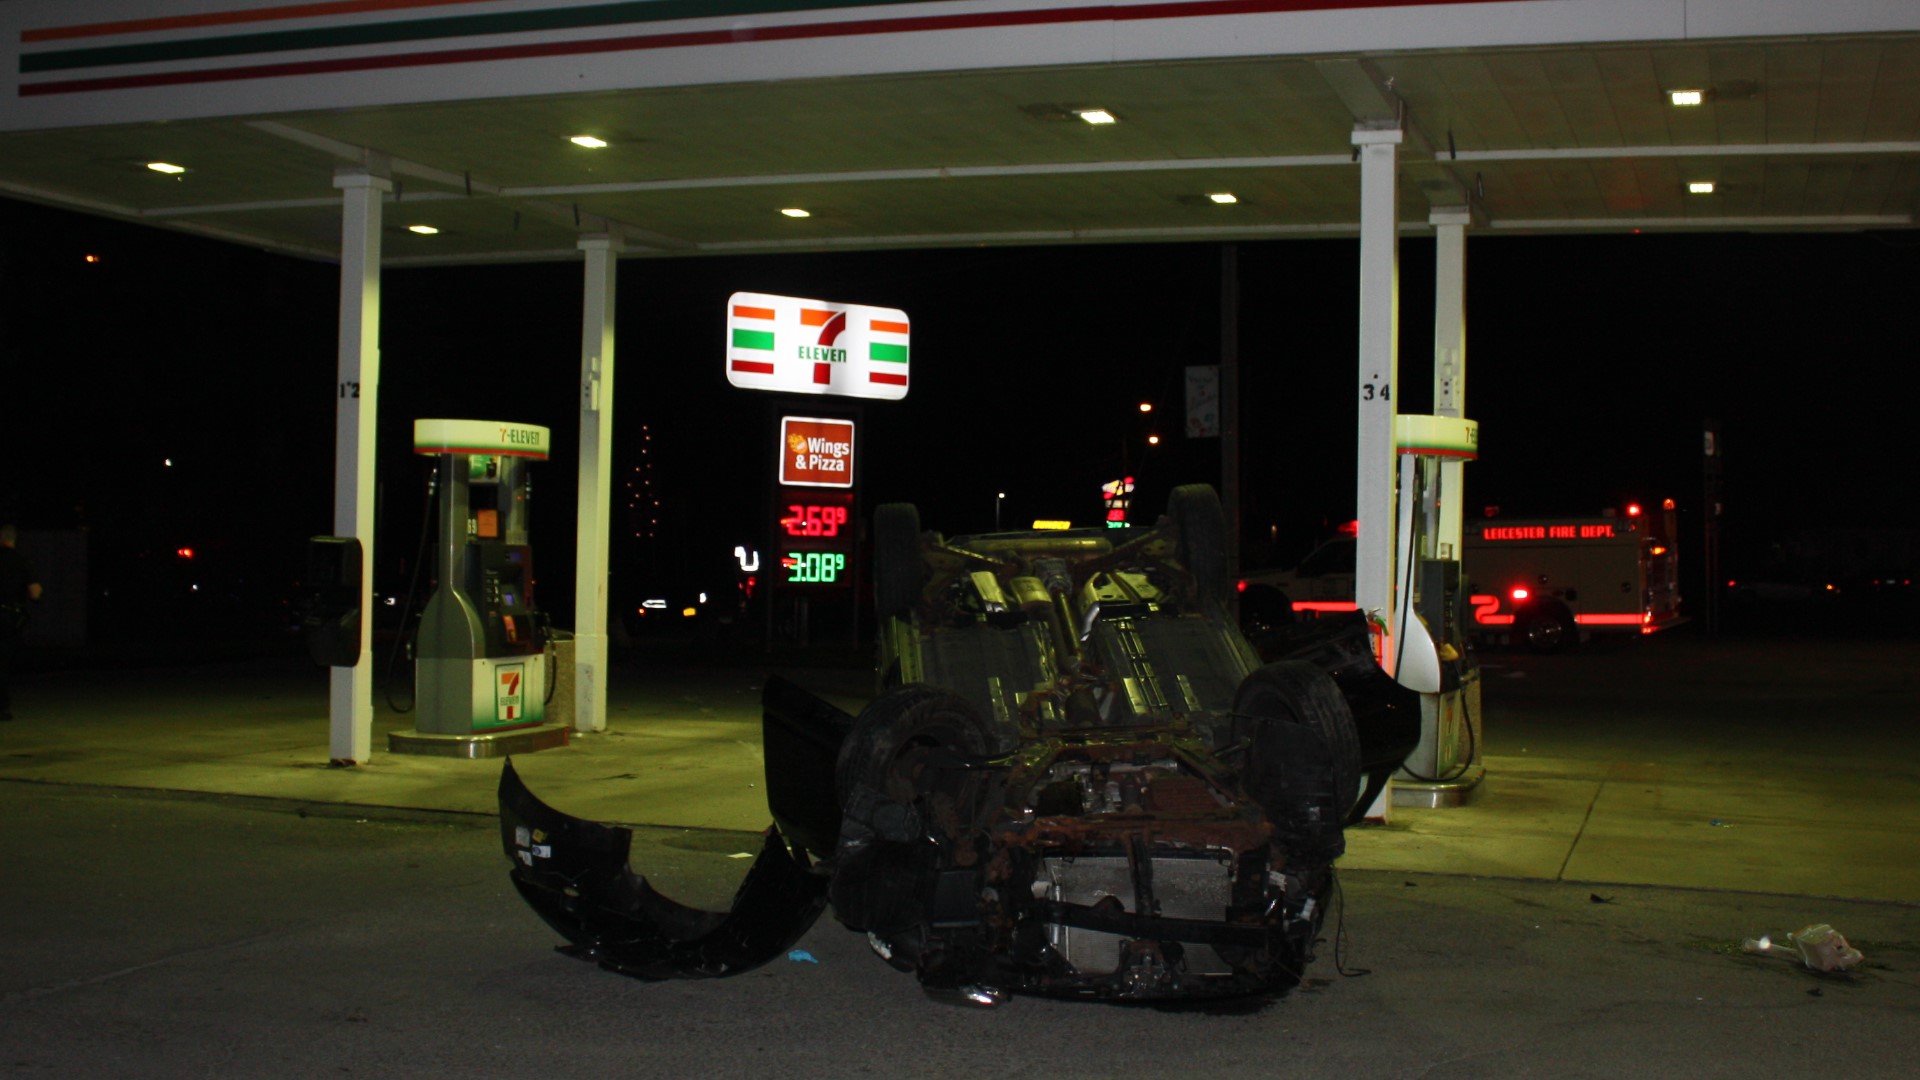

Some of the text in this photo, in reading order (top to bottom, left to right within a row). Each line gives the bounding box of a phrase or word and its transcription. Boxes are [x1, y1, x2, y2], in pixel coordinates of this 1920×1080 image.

[798, 345, 847, 363] ELEVEN
[800, 308, 846, 385] 7
[351, 383, 360, 398] 2
[1363, 384, 1390, 400] 3 4
[499, 428, 540, 446] 7-ELEVEN
[807, 437, 850, 458] Wings
[795, 455, 845, 472] & Pizza
[1483, 524, 1616, 541] LEICESTER FIRE DEPT.
[501, 672, 519, 720] 7
